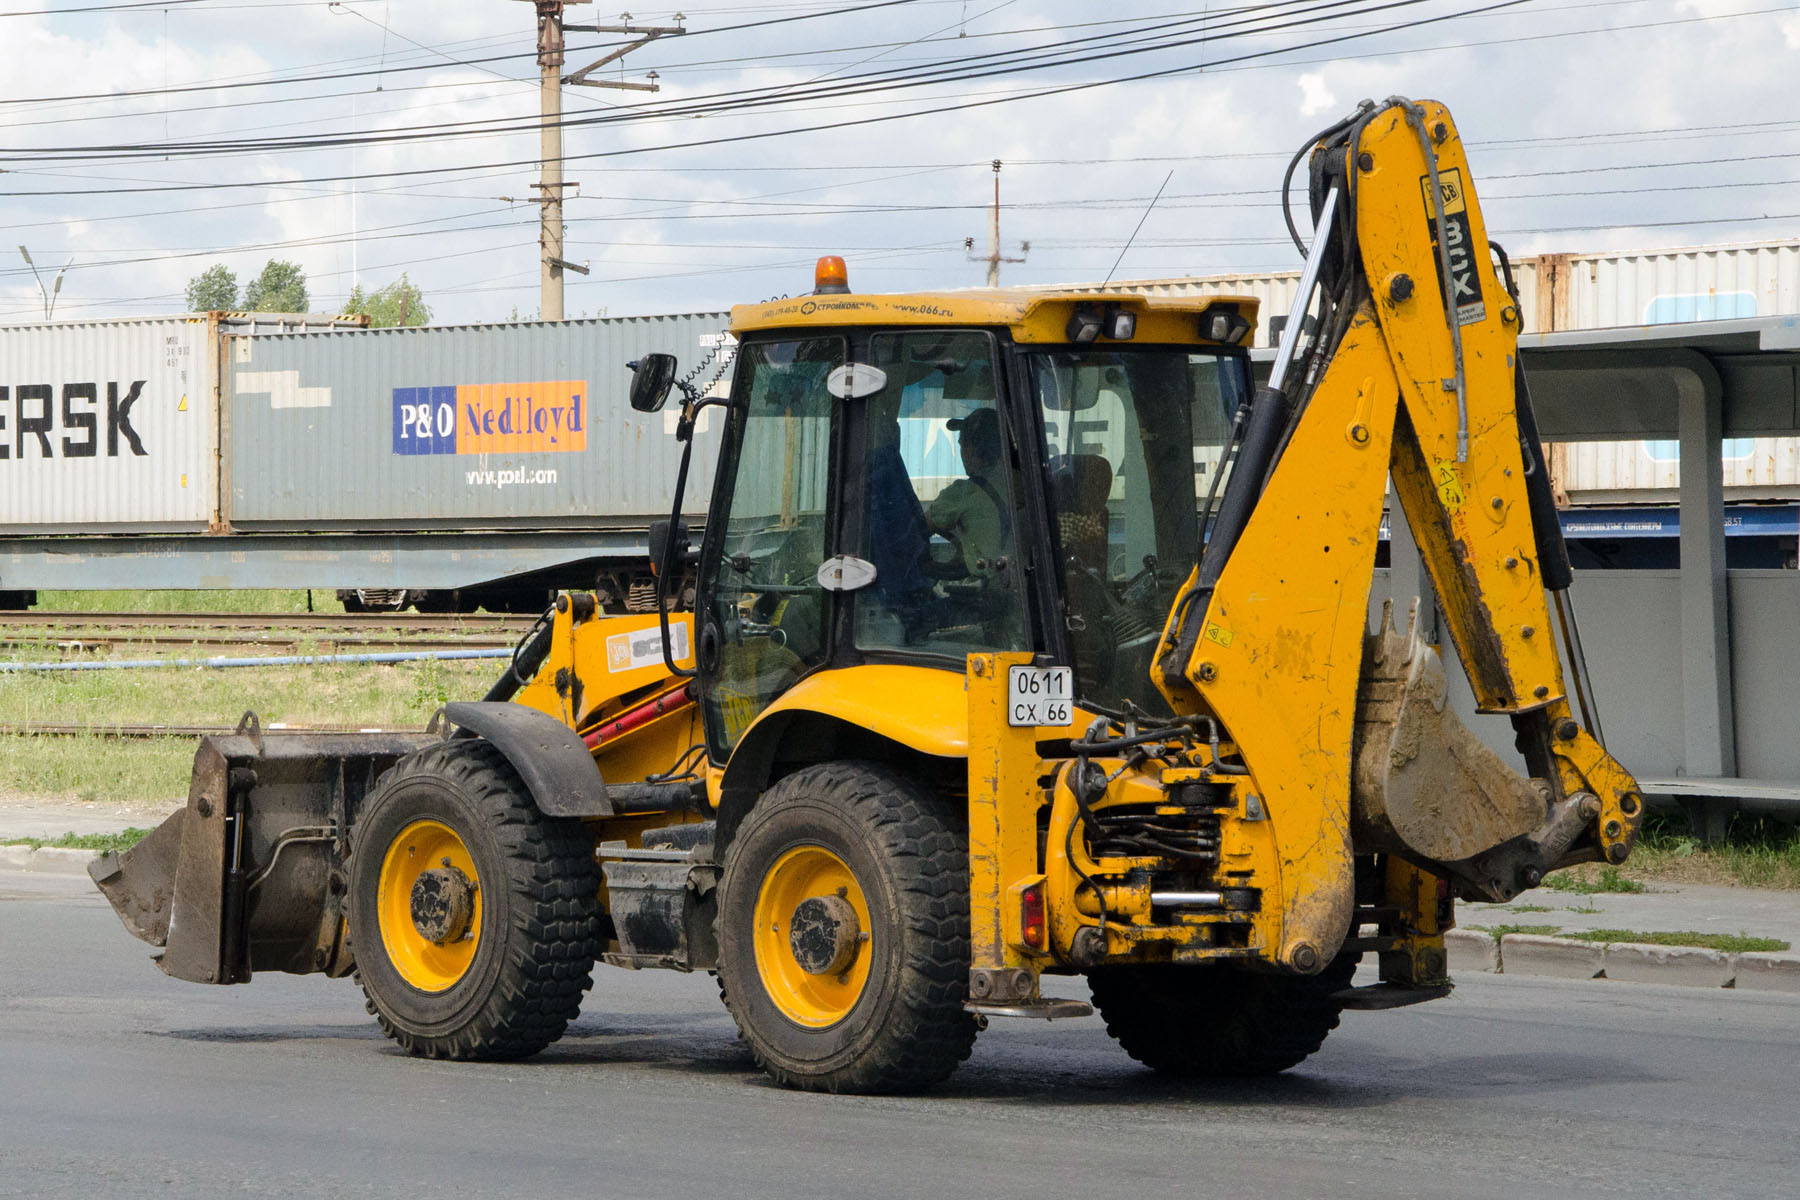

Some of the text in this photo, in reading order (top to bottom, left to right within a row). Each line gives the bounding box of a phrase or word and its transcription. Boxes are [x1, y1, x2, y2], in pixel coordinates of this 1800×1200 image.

[0, 380, 149, 460] RSK
[400, 394, 584, 444] P&O Nedlloyd
[1018, 672, 1062, 694] 0611
[1015, 704, 1067, 721] CX 66
